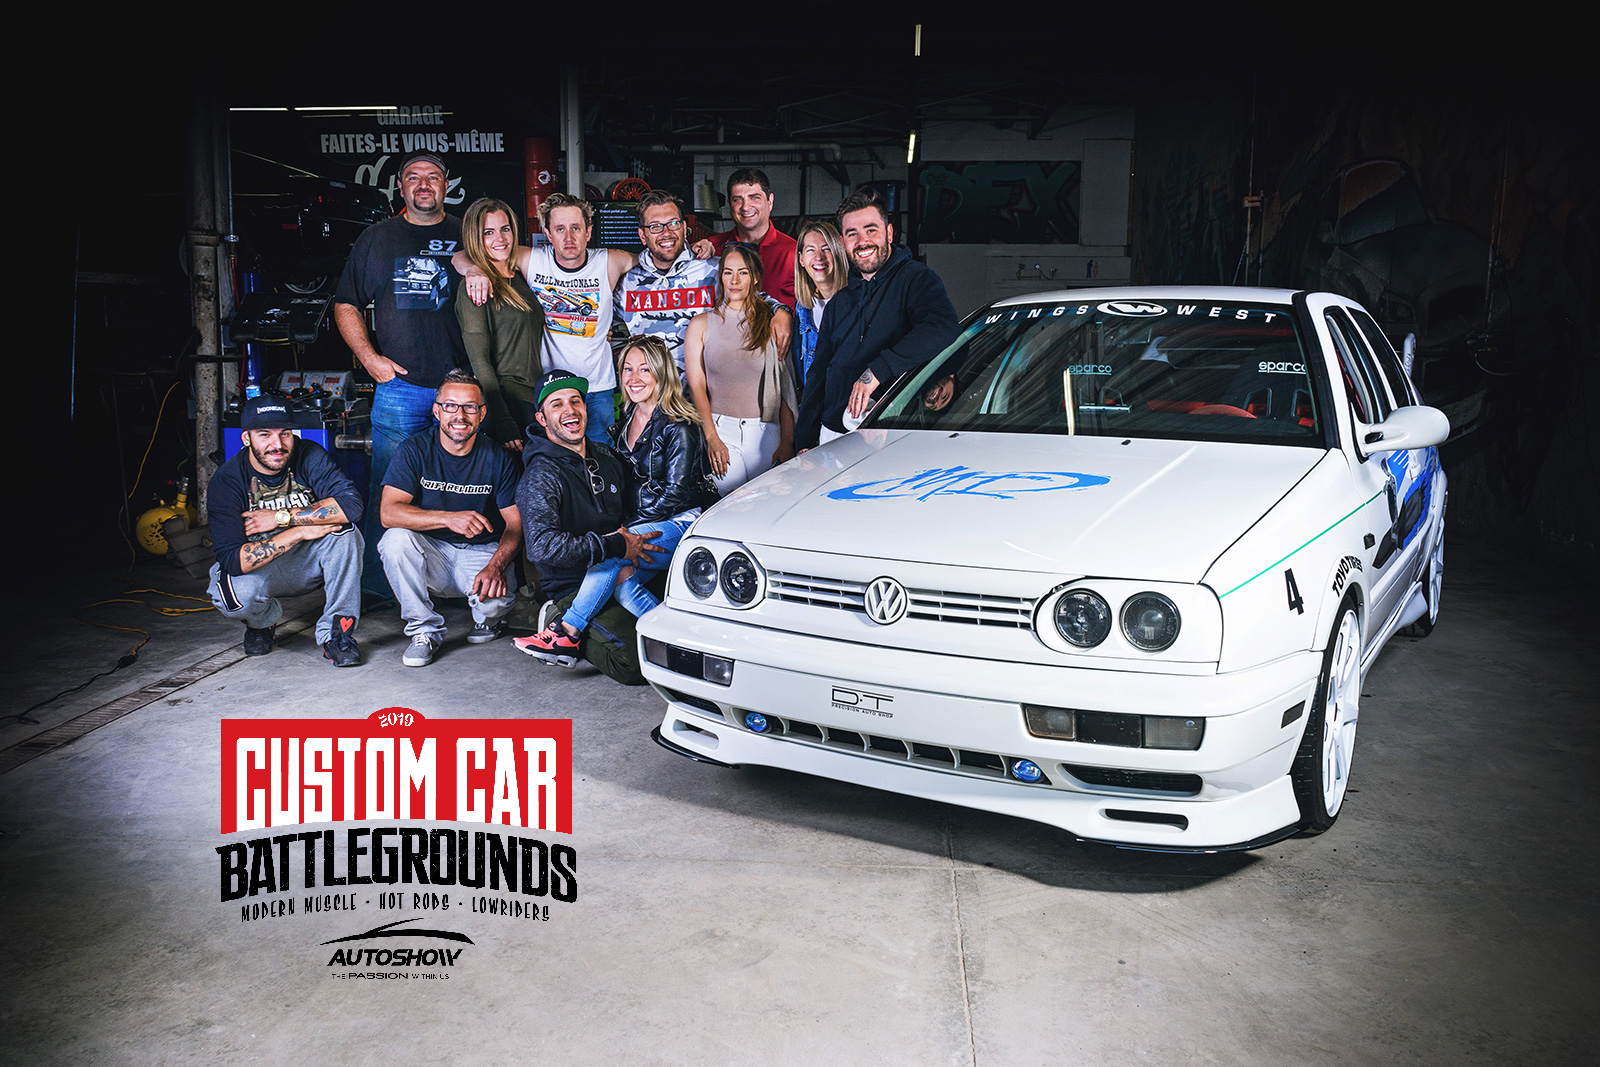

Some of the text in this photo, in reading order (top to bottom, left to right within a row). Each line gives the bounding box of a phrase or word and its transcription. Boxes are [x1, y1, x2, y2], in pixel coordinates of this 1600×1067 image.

[377, 105, 444, 125] GARAGE
[320, 129, 504, 154] FAITES-LE VOUS-MÊME
[428, 239, 457, 252] 87
[631, 289, 711, 309] MANSON
[985, 304, 1089, 325] WINGS
[1176, 304, 1276, 324] WEST
[446, 483, 493, 495] RELIGION
[1284, 567, 1305, 616] 4
[831, 703, 860, 713] PRECISION
[861, 708, 877, 716] AUTO
